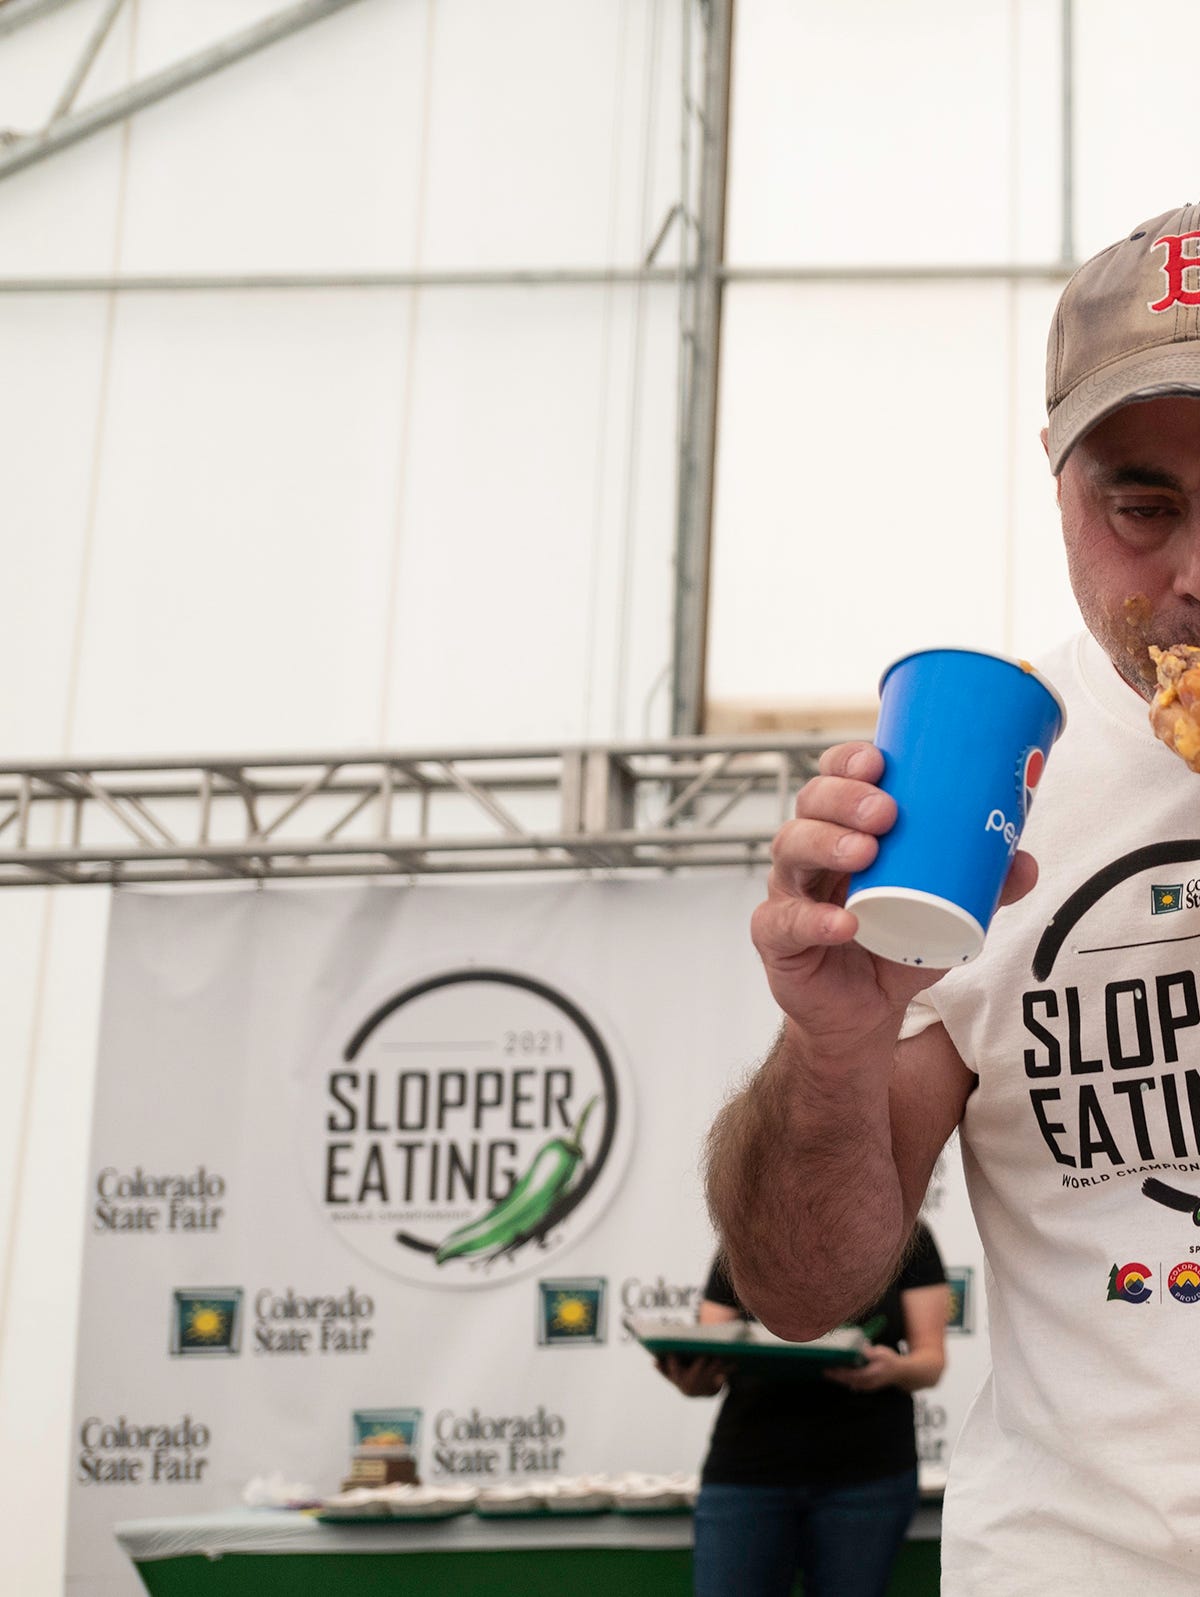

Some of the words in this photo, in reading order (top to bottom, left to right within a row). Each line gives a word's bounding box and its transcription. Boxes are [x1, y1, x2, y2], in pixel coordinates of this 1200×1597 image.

[504, 1030, 565, 1054] 2021
[326, 1068, 574, 1132] SLOPPER
[97, 1166, 225, 1199] Colorado
[324, 1140, 518, 1204] EATING
[1062, 1174, 1110, 1189] WORLD
[95, 1198, 160, 1233] State
[168, 1199, 223, 1232] Fair
[255, 1285, 374, 1319] Colorado
[621, 1277, 699, 1311] Color
[254, 1319, 313, 1355] State
[320, 1318, 373, 1353] Fair
[80, 1416, 210, 1449] Colorado
[433, 1406, 566, 1441] Colorado
[79, 1449, 143, 1484] State
[152, 1448, 208, 1482] Fair
[432, 1441, 498, 1476] State
[508, 1440, 564, 1474] Fair
